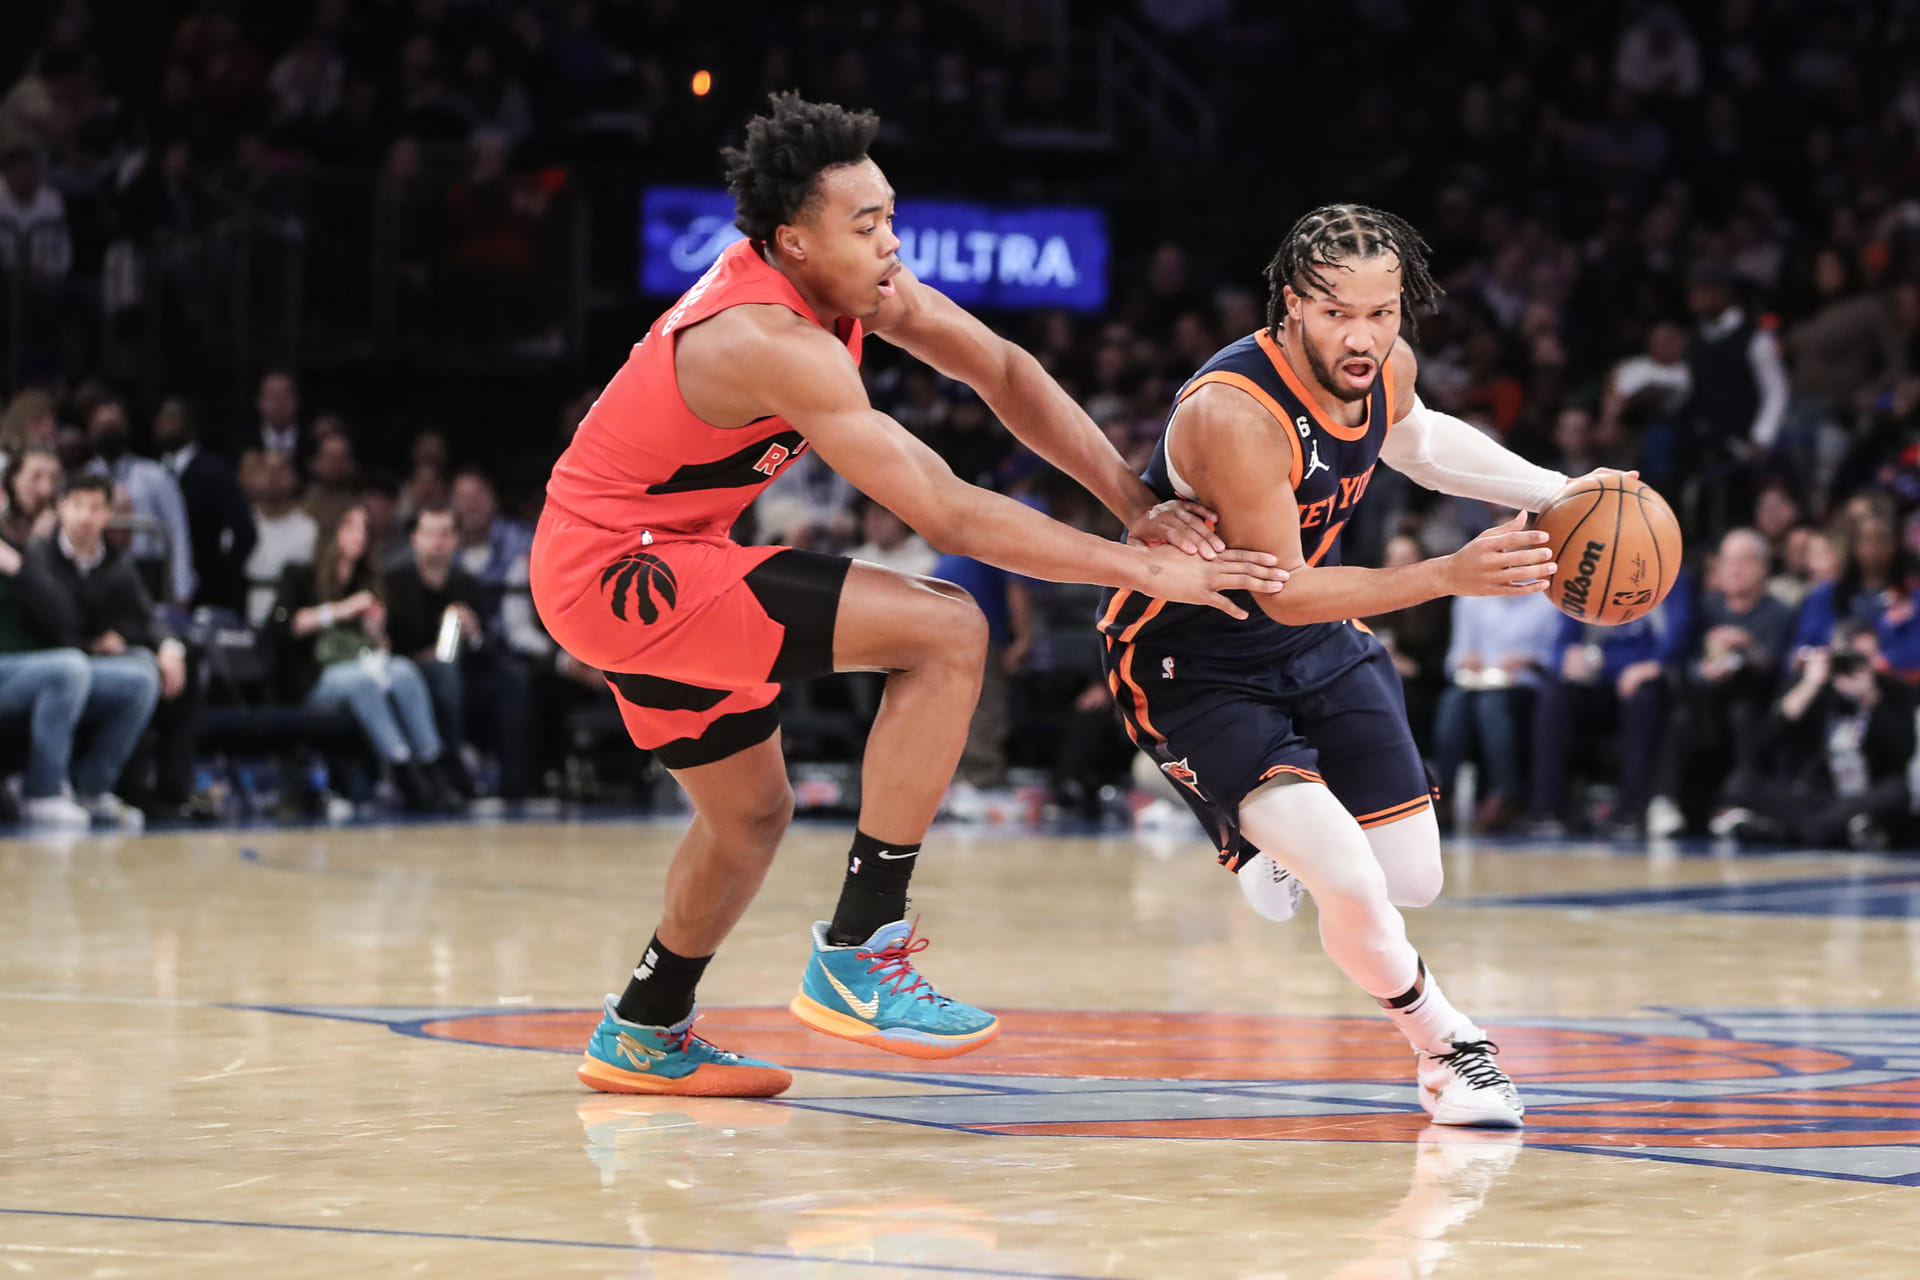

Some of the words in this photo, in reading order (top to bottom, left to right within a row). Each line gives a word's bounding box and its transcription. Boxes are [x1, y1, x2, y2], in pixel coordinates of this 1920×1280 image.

[898, 228, 1076, 287] ULTRA
[1296, 415, 1312, 438] 6
[1560, 540, 1606, 618] Wilson
